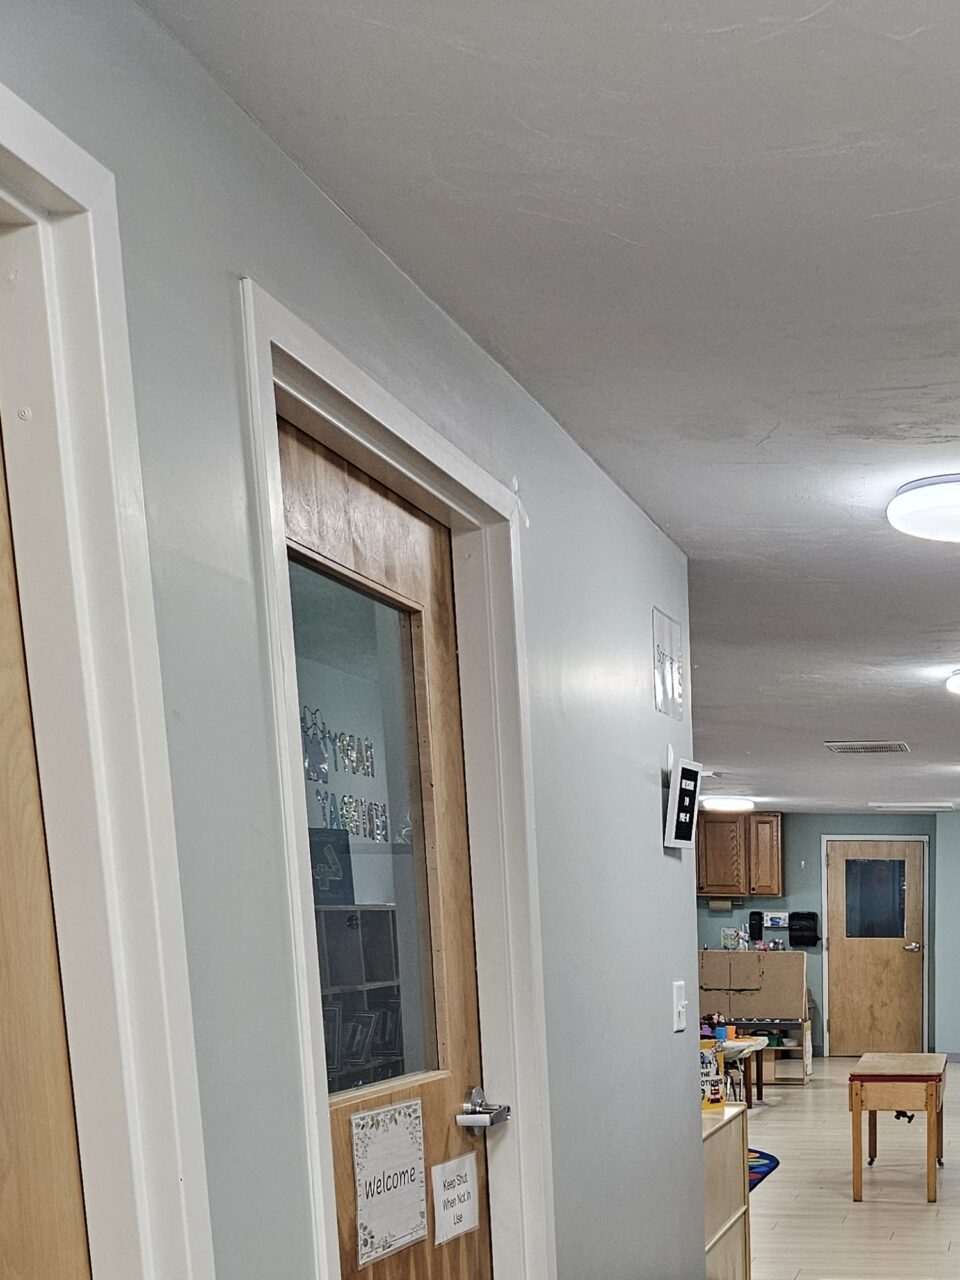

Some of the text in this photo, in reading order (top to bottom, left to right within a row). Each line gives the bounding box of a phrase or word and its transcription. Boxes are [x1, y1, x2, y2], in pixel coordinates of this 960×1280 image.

[701, 1078, 722, 1086] OTIONS
[364, 1166, 416, 1200] Welcome
[443, 1172, 468, 1192] Keep Shut
[442, 1197, 457, 1211] When
[453, 1212, 463, 1226] Use
